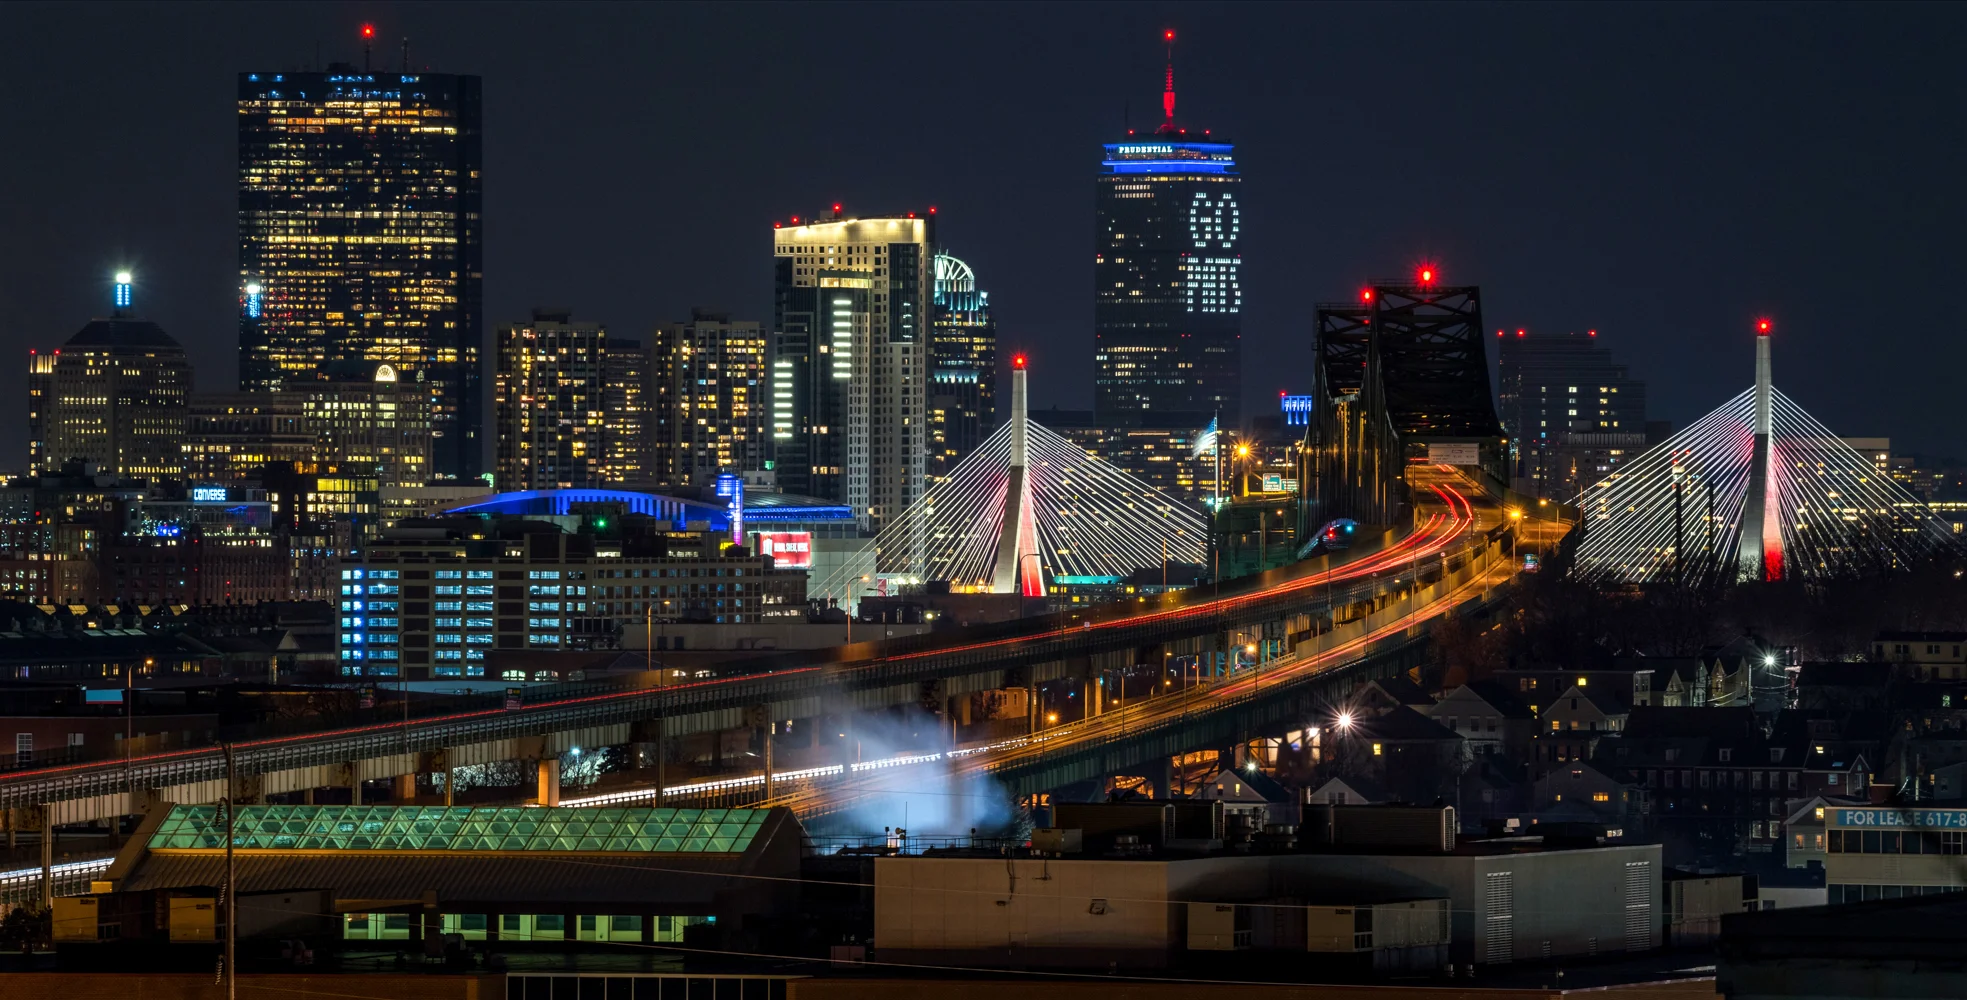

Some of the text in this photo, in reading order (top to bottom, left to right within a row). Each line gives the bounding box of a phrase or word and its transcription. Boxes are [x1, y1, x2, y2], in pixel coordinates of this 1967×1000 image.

[1190, 192, 1239, 248] GO
[1187, 257, 1242, 313] PATS
[193, 488, 226, 501] CONVERSE
[1846, 811, 1967, 827] FOR LEASE 617-8
